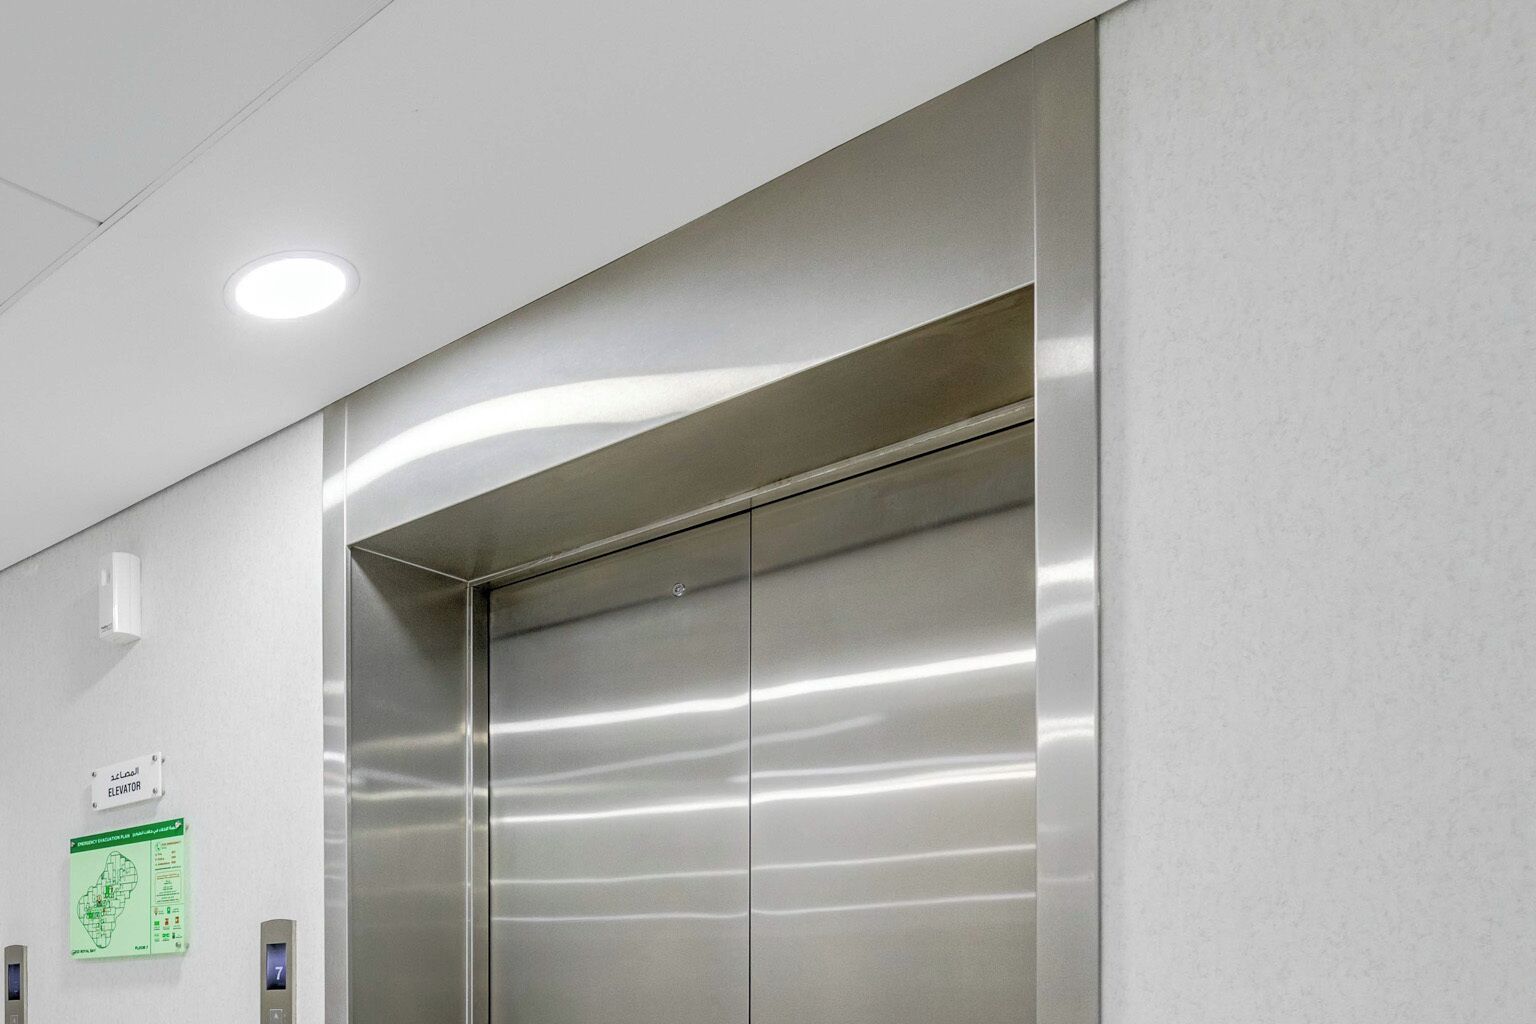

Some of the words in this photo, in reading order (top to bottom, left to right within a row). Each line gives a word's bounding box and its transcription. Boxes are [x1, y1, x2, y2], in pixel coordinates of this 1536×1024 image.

[110, 766, 139, 781] المصاعد
[108, 780, 141, 797] ELEVATOR
[275, 966, 283, 980] 7
